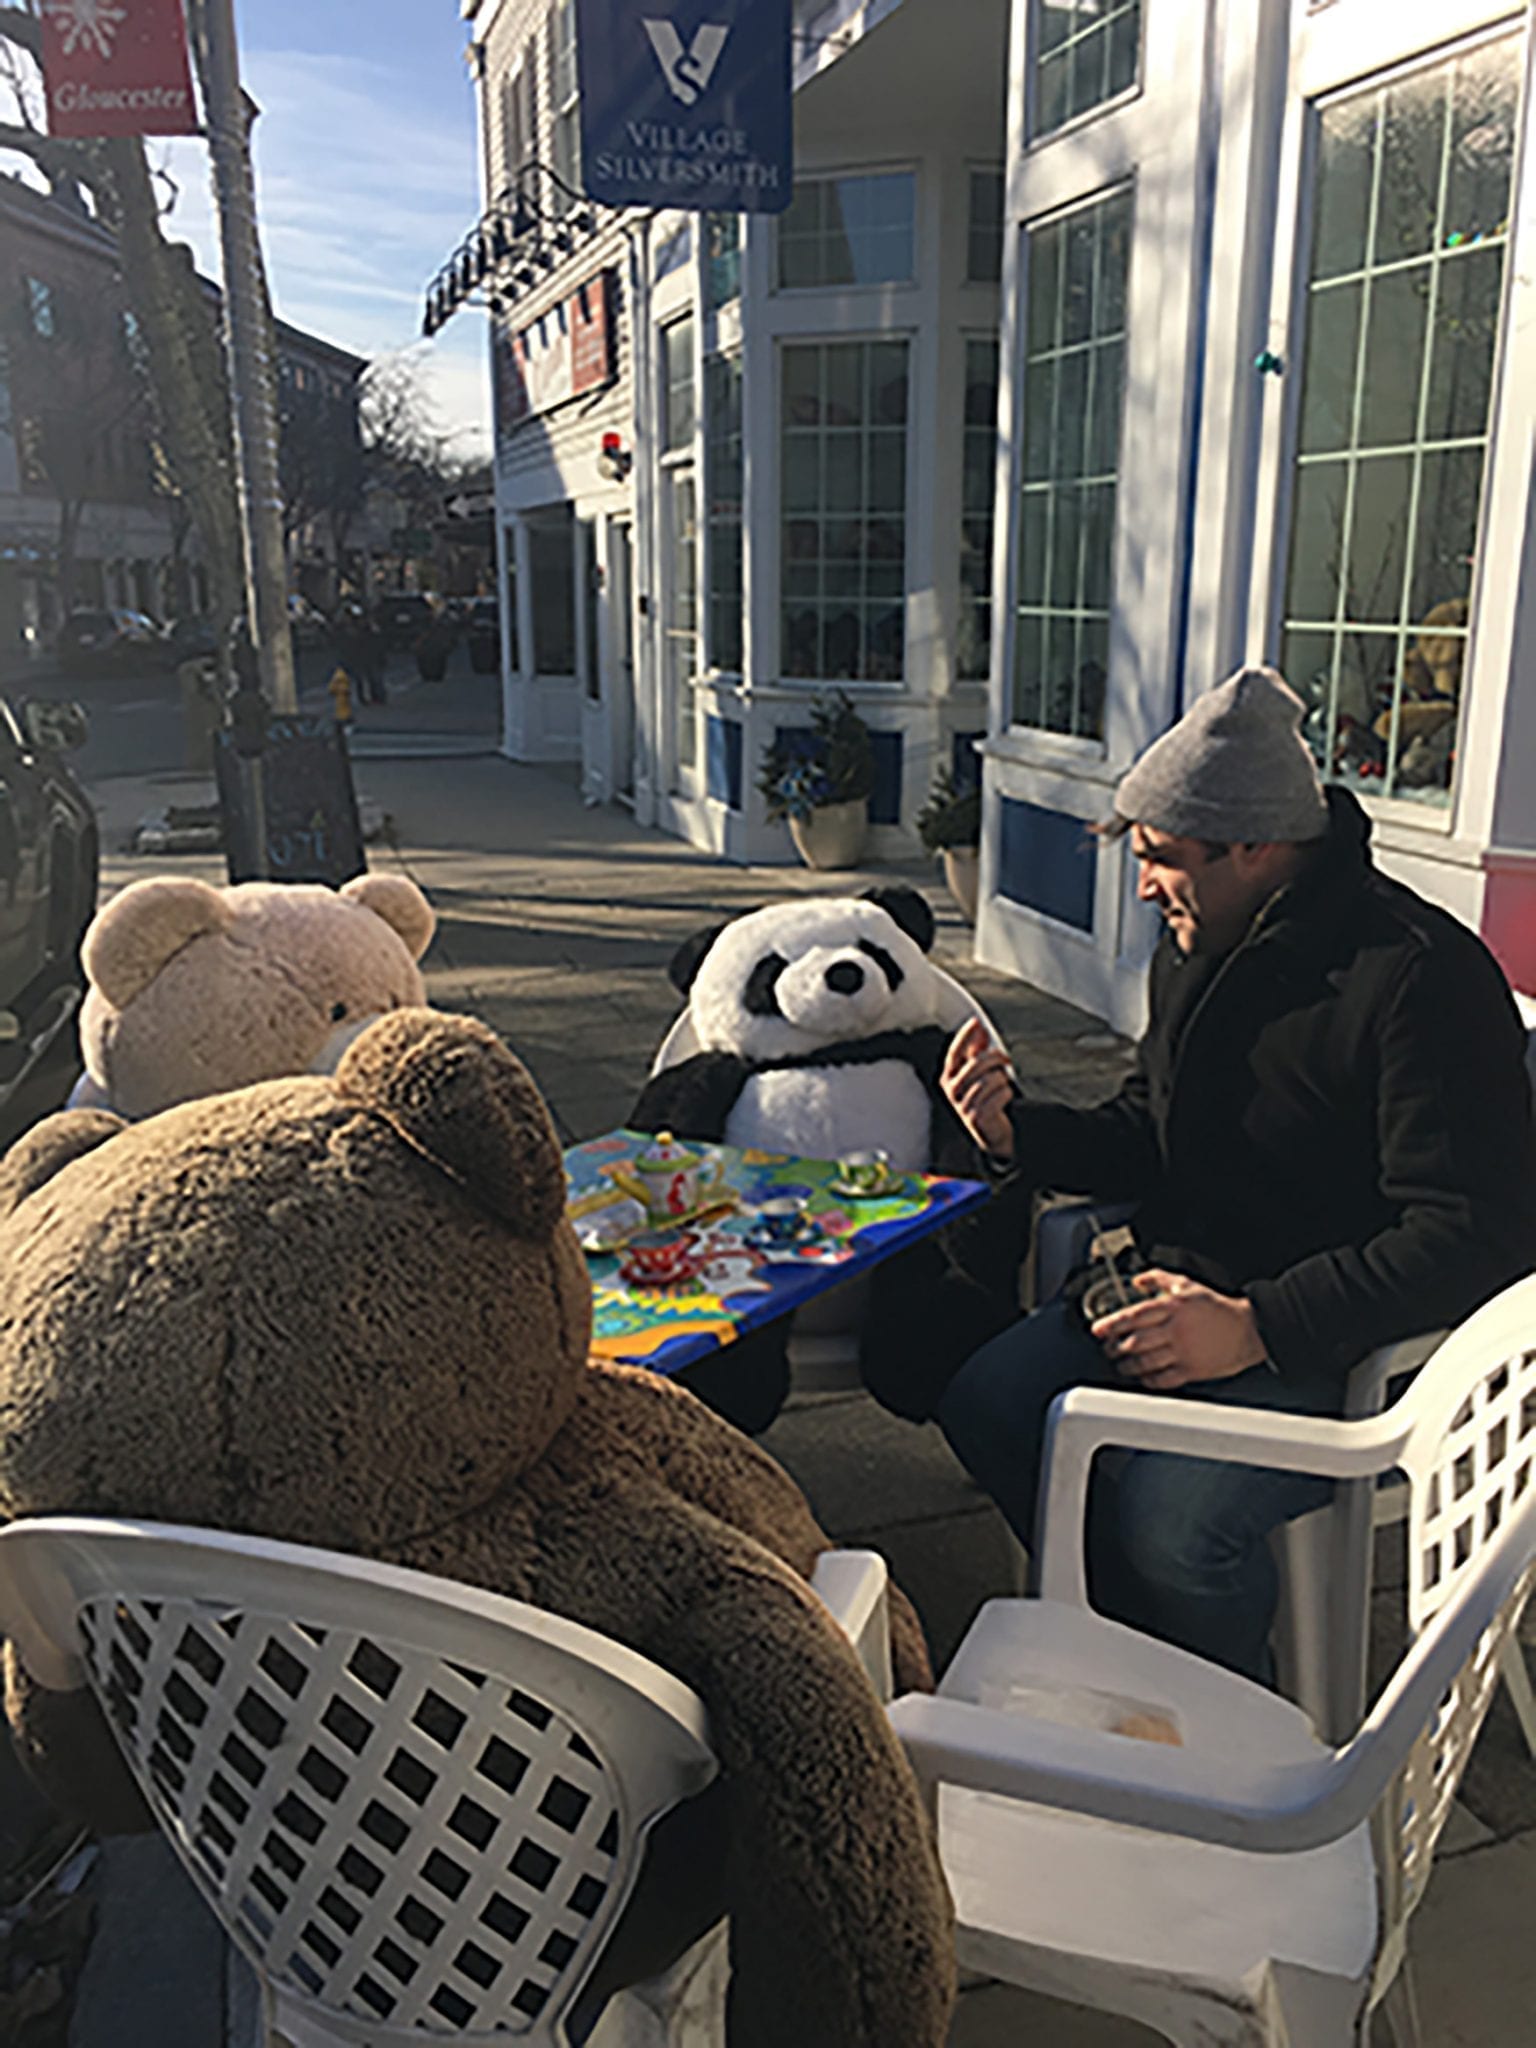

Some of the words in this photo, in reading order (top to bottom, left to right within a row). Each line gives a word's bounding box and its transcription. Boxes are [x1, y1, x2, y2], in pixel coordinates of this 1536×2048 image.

[53, 81, 187, 112] Gloucester
[626, 120, 748, 154] VILLAGE
[595, 152, 779, 188] SILVERSMITH
